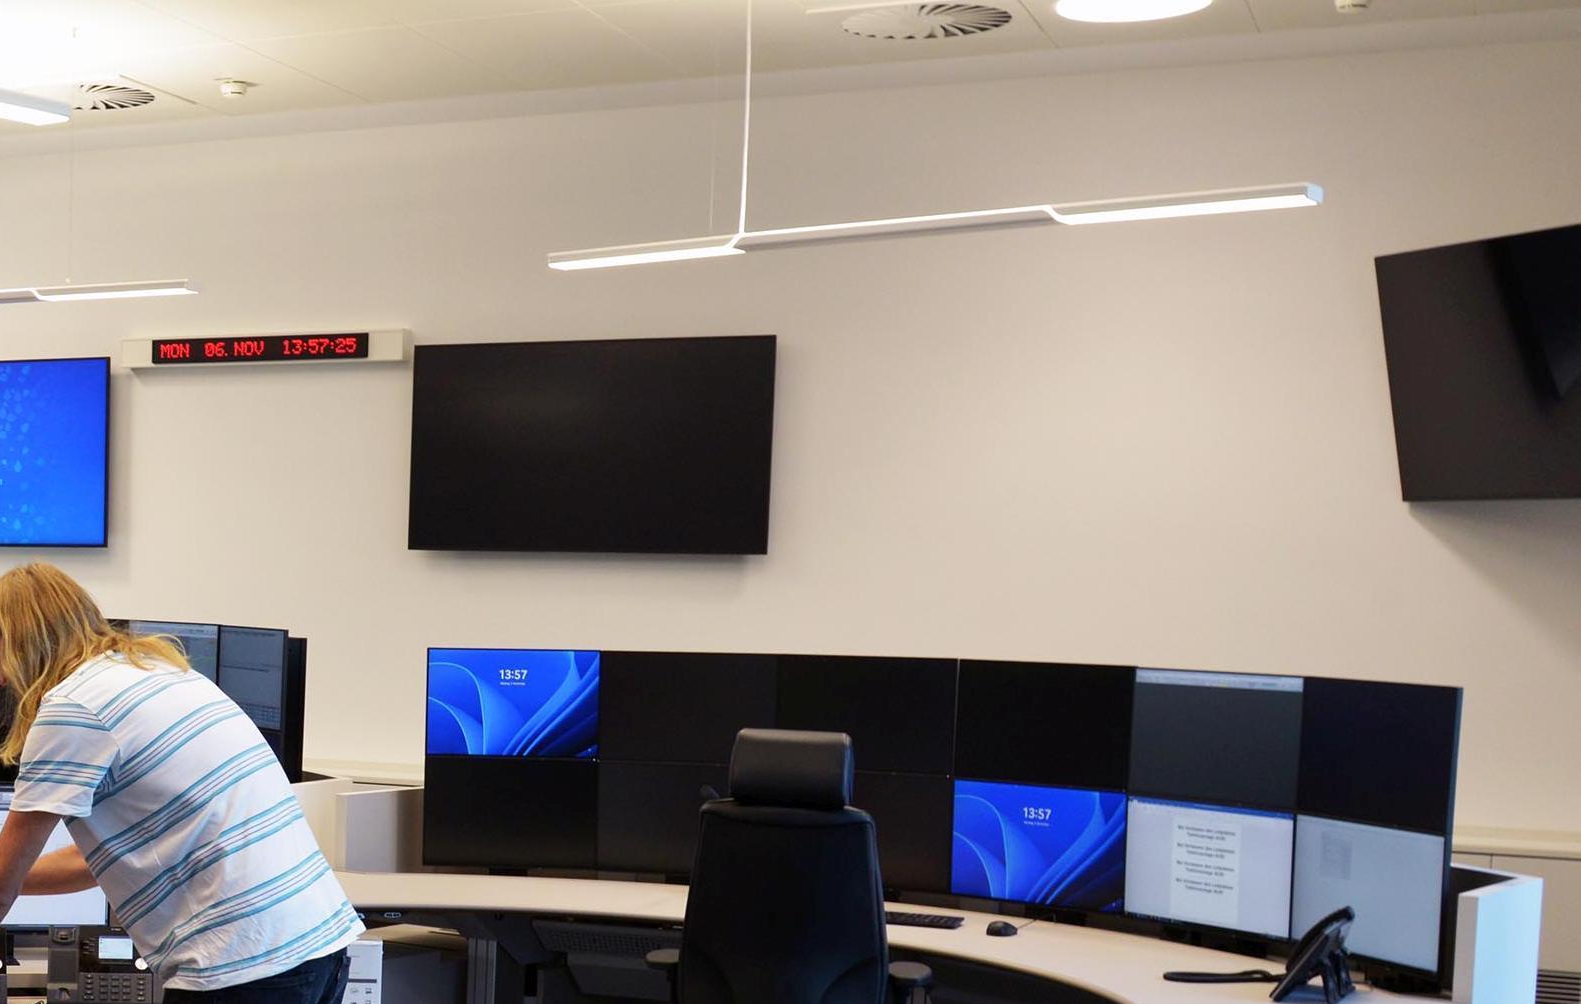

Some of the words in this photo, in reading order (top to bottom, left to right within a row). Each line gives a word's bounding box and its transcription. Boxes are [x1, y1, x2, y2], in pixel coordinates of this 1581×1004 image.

[160, 343, 190, 359] MON
[204, 342, 228, 357] 06.
[234, 341, 265, 356] NOV
[283, 338, 357, 355] 13:57:25
[499, 669, 528, 680] 13:57
[1023, 807, 1052, 821] 13:57
